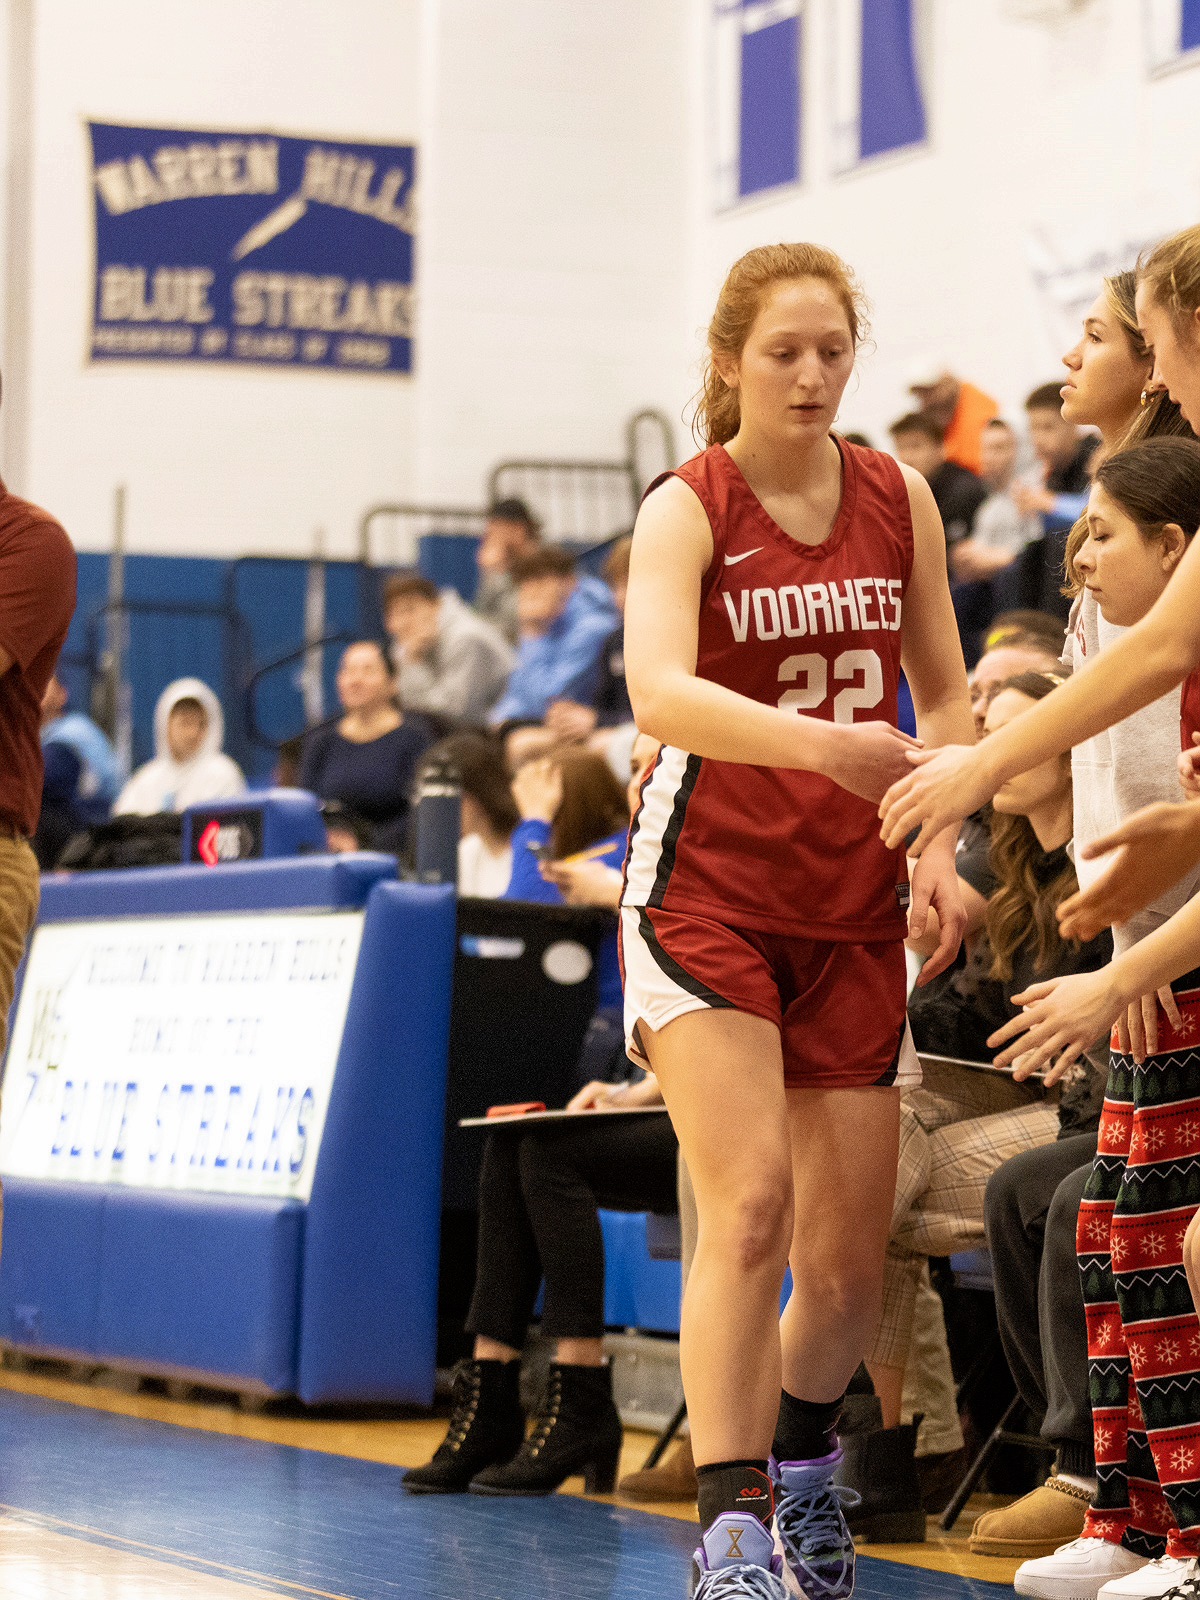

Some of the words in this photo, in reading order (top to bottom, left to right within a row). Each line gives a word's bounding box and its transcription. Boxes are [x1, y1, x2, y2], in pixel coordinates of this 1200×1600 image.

[97, 138, 279, 216] WARREN
[101, 265, 214, 324] BLUE
[722, 577, 902, 642] VOORHEES
[777, 649, 884, 724] 22
